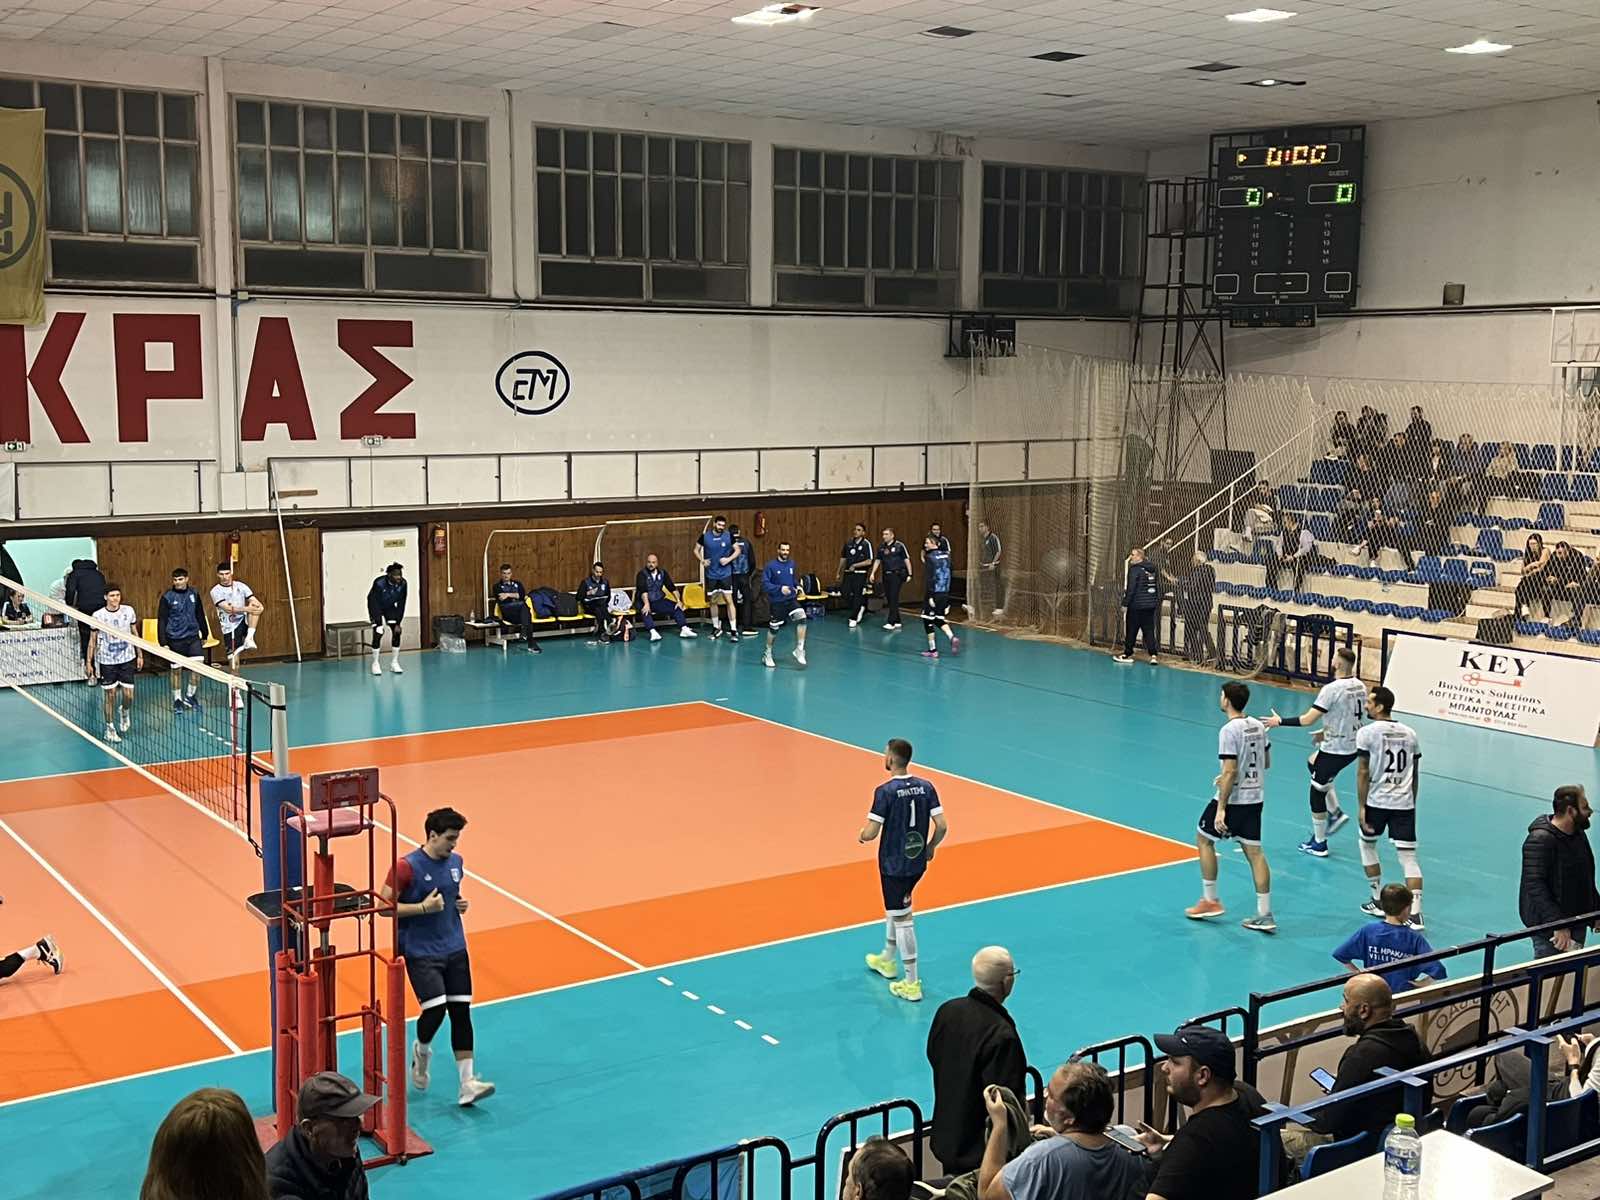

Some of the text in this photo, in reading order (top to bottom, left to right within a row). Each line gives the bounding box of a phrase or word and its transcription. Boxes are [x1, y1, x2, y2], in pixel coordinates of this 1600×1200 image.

[1246, 187, 1261, 206] 0
[1336, 183, 1353, 203] 0
[1457, 650, 1536, 677] KEY
[1438, 680, 1543, 705] Business Solutions
[1449, 702, 1518, 721] ΜΠΑΝΤΟΥΛΑΣ
[1495, 701, 1546, 716] ΜΕΣΙΤΙΚΑ
[1384, 748, 1407, 773] 20
[909, 799, 916, 827] 1
